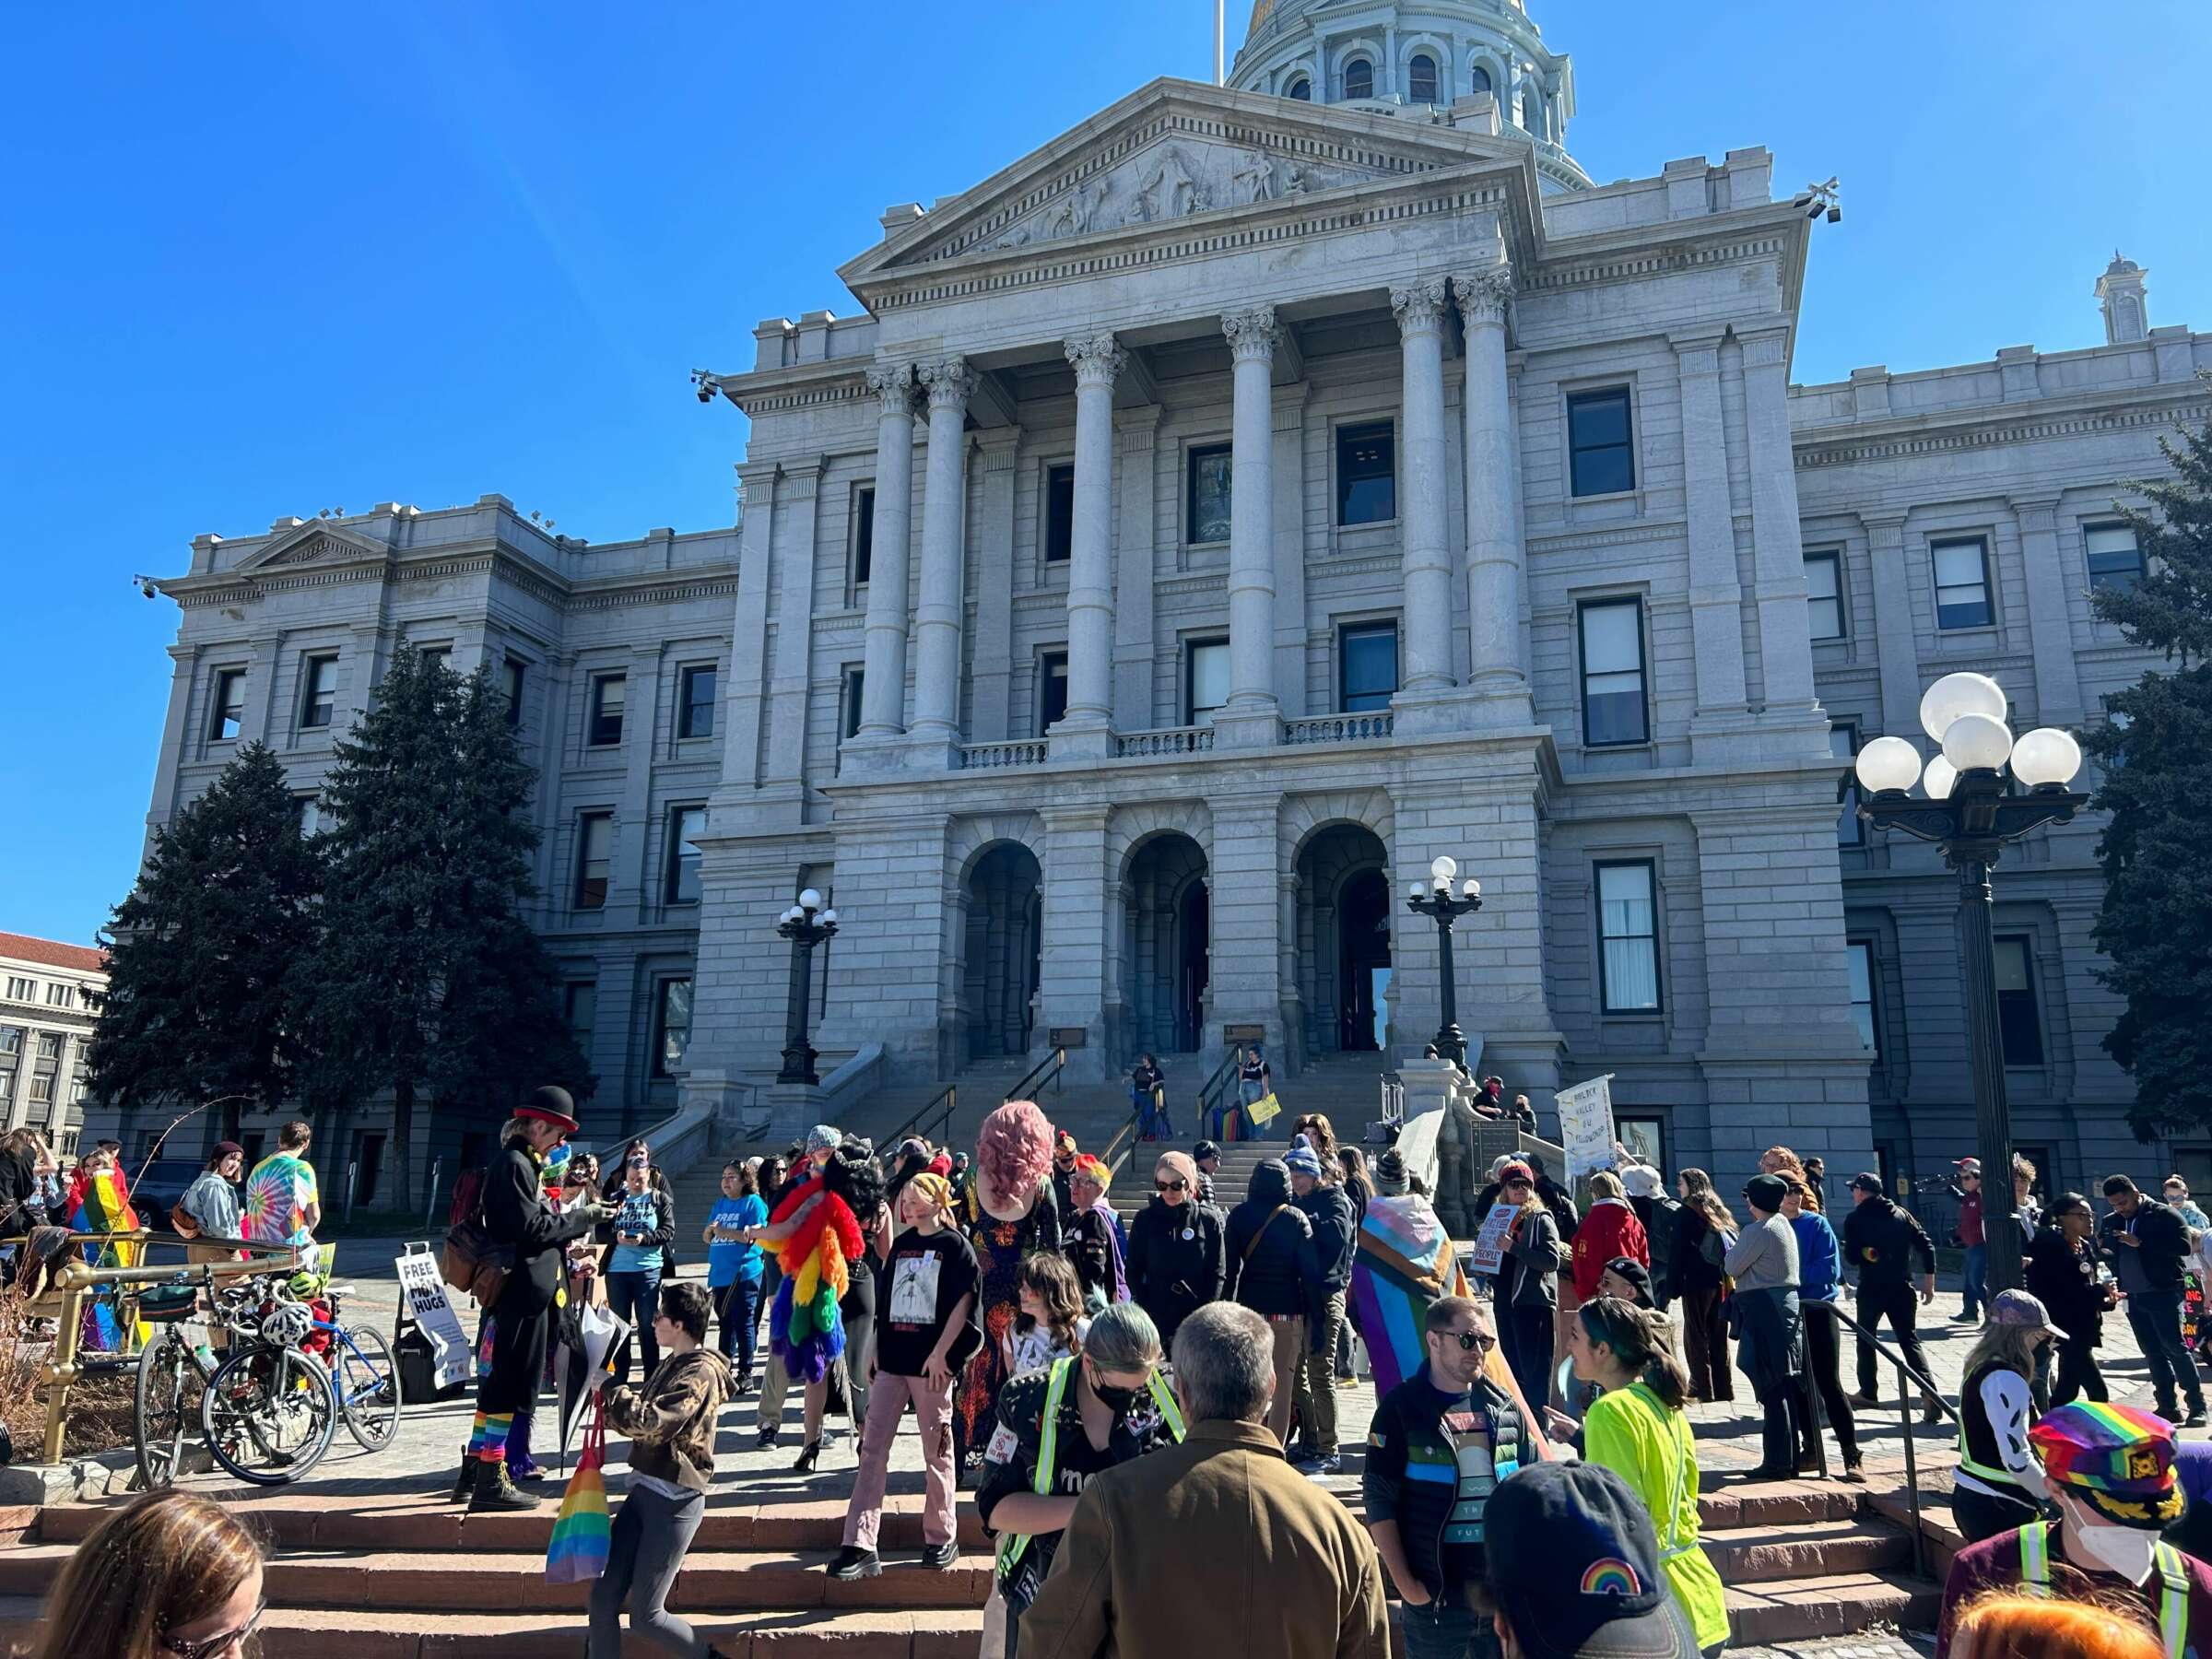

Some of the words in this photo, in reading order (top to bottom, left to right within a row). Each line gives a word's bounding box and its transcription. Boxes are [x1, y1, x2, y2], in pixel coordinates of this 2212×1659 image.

[617, 1221, 649, 1230] HUGS
[403, 1262, 433, 1279] FREE
[408, 1279, 441, 1299] MOM
[414, 1296, 446, 1314] HUGS
